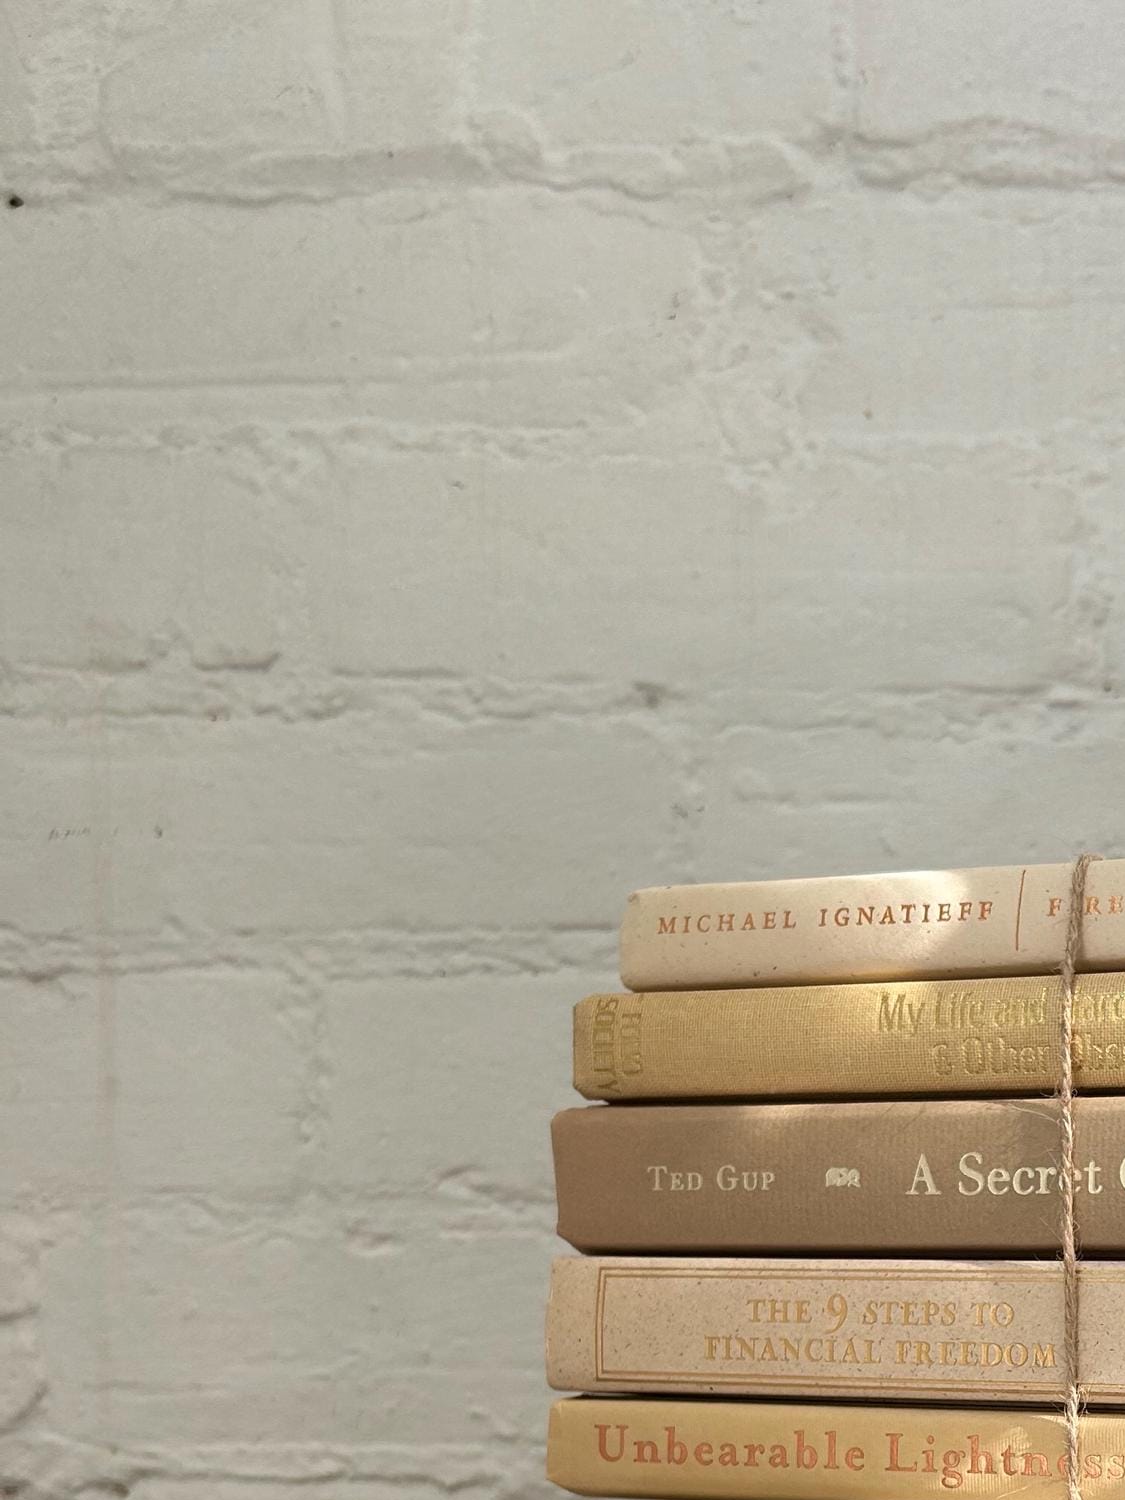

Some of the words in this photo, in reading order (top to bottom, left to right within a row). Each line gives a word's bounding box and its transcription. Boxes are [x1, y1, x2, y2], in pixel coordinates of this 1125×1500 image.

[657, 910, 796, 935] MICHAEL
[819, 901, 993, 928] IGNATIEFF
[1046, 895, 1124, 917] FRE
[878, 990, 925, 1036] My
[934, 989, 984, 1027] Life
[993, 986, 1047, 1026] and
[961, 1035, 1050, 1076] Other
[647, 1165, 702, 1191] TED
[717, 1165, 775, 1191] GUP
[905, 1154, 941, 1195] A
[747, 1299, 812, 1325] THE
[826, 1293, 849, 1334] 9
[862, 1300, 957, 1327] STEPS
[970, 1302, 1016, 1328] TO
[705, 1335, 883, 1364] FINANCIAL
[896, 1340, 1057, 1369] FREEDOM
[594, 1424, 866, 1471] Unbearable
